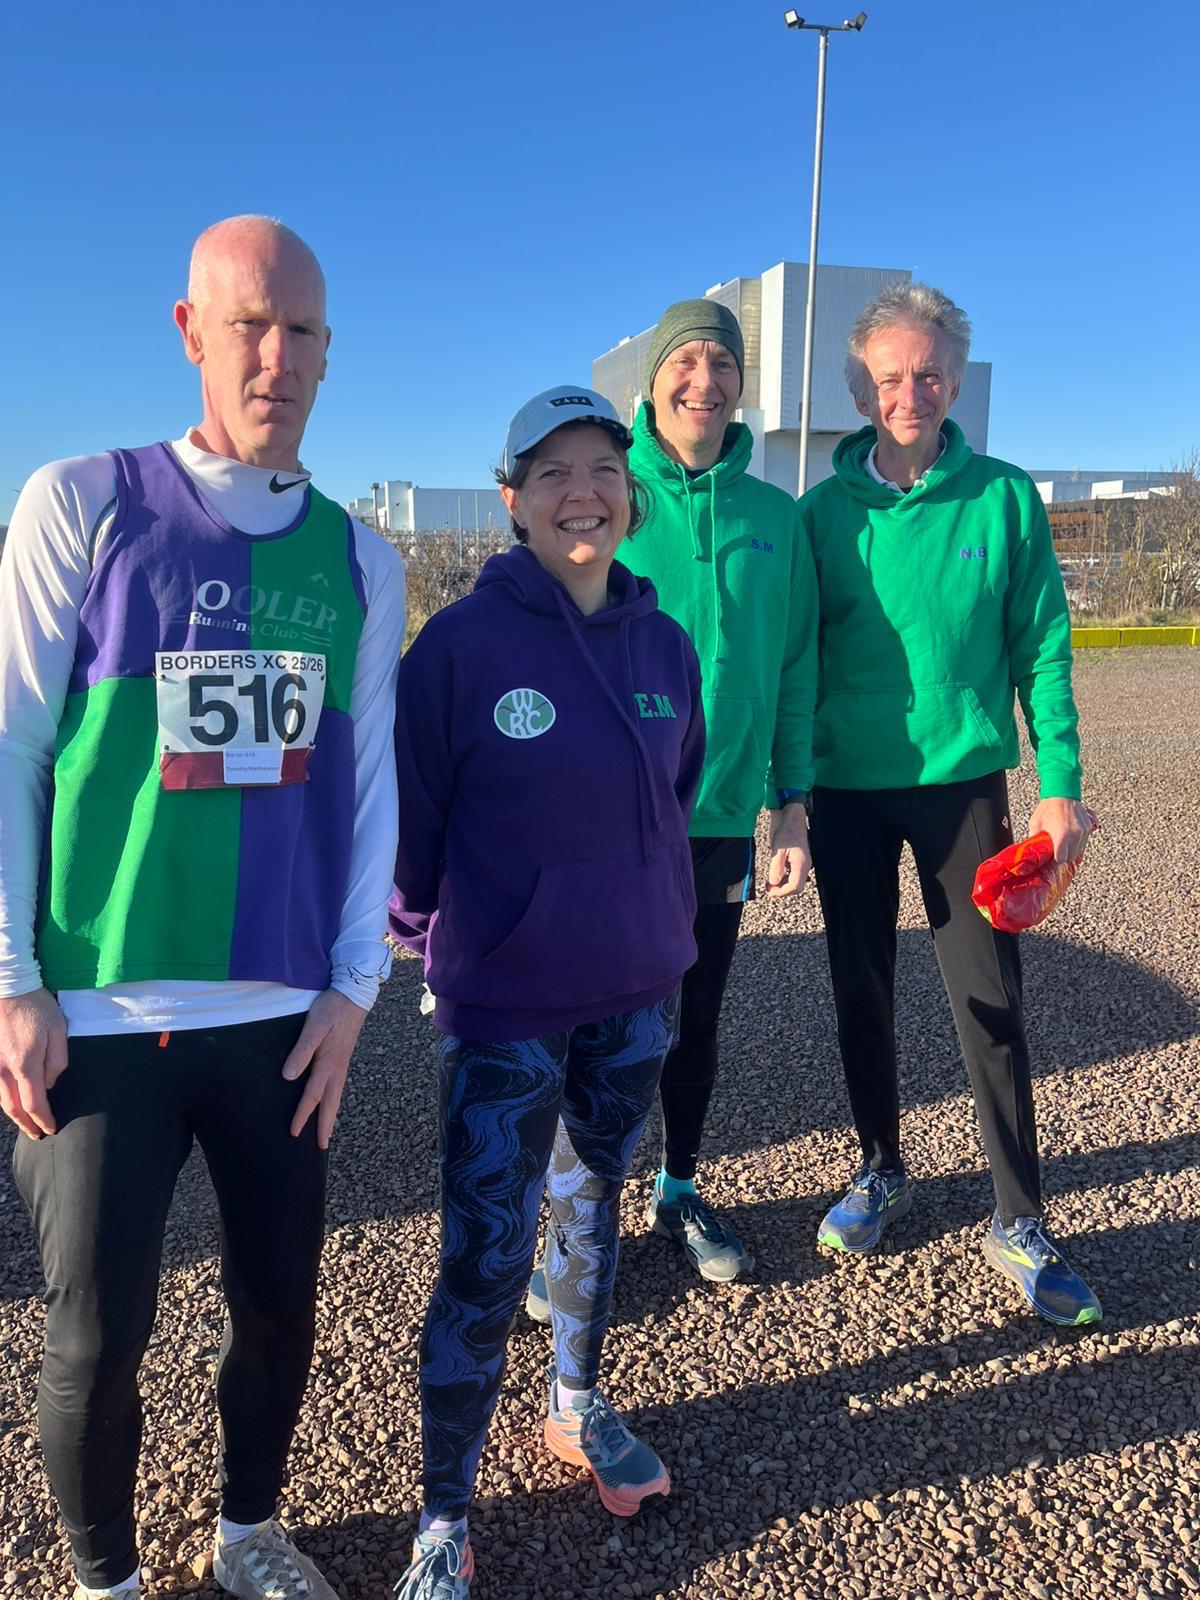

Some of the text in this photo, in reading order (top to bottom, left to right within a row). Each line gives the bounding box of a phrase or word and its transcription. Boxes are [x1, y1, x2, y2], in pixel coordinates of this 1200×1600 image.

[189, 611, 299, 640] Running Club
[160, 654, 324, 672] BORDERS XC 25/26
[188, 673, 308, 746] 516
[633, 692, 678, 718] E.M
